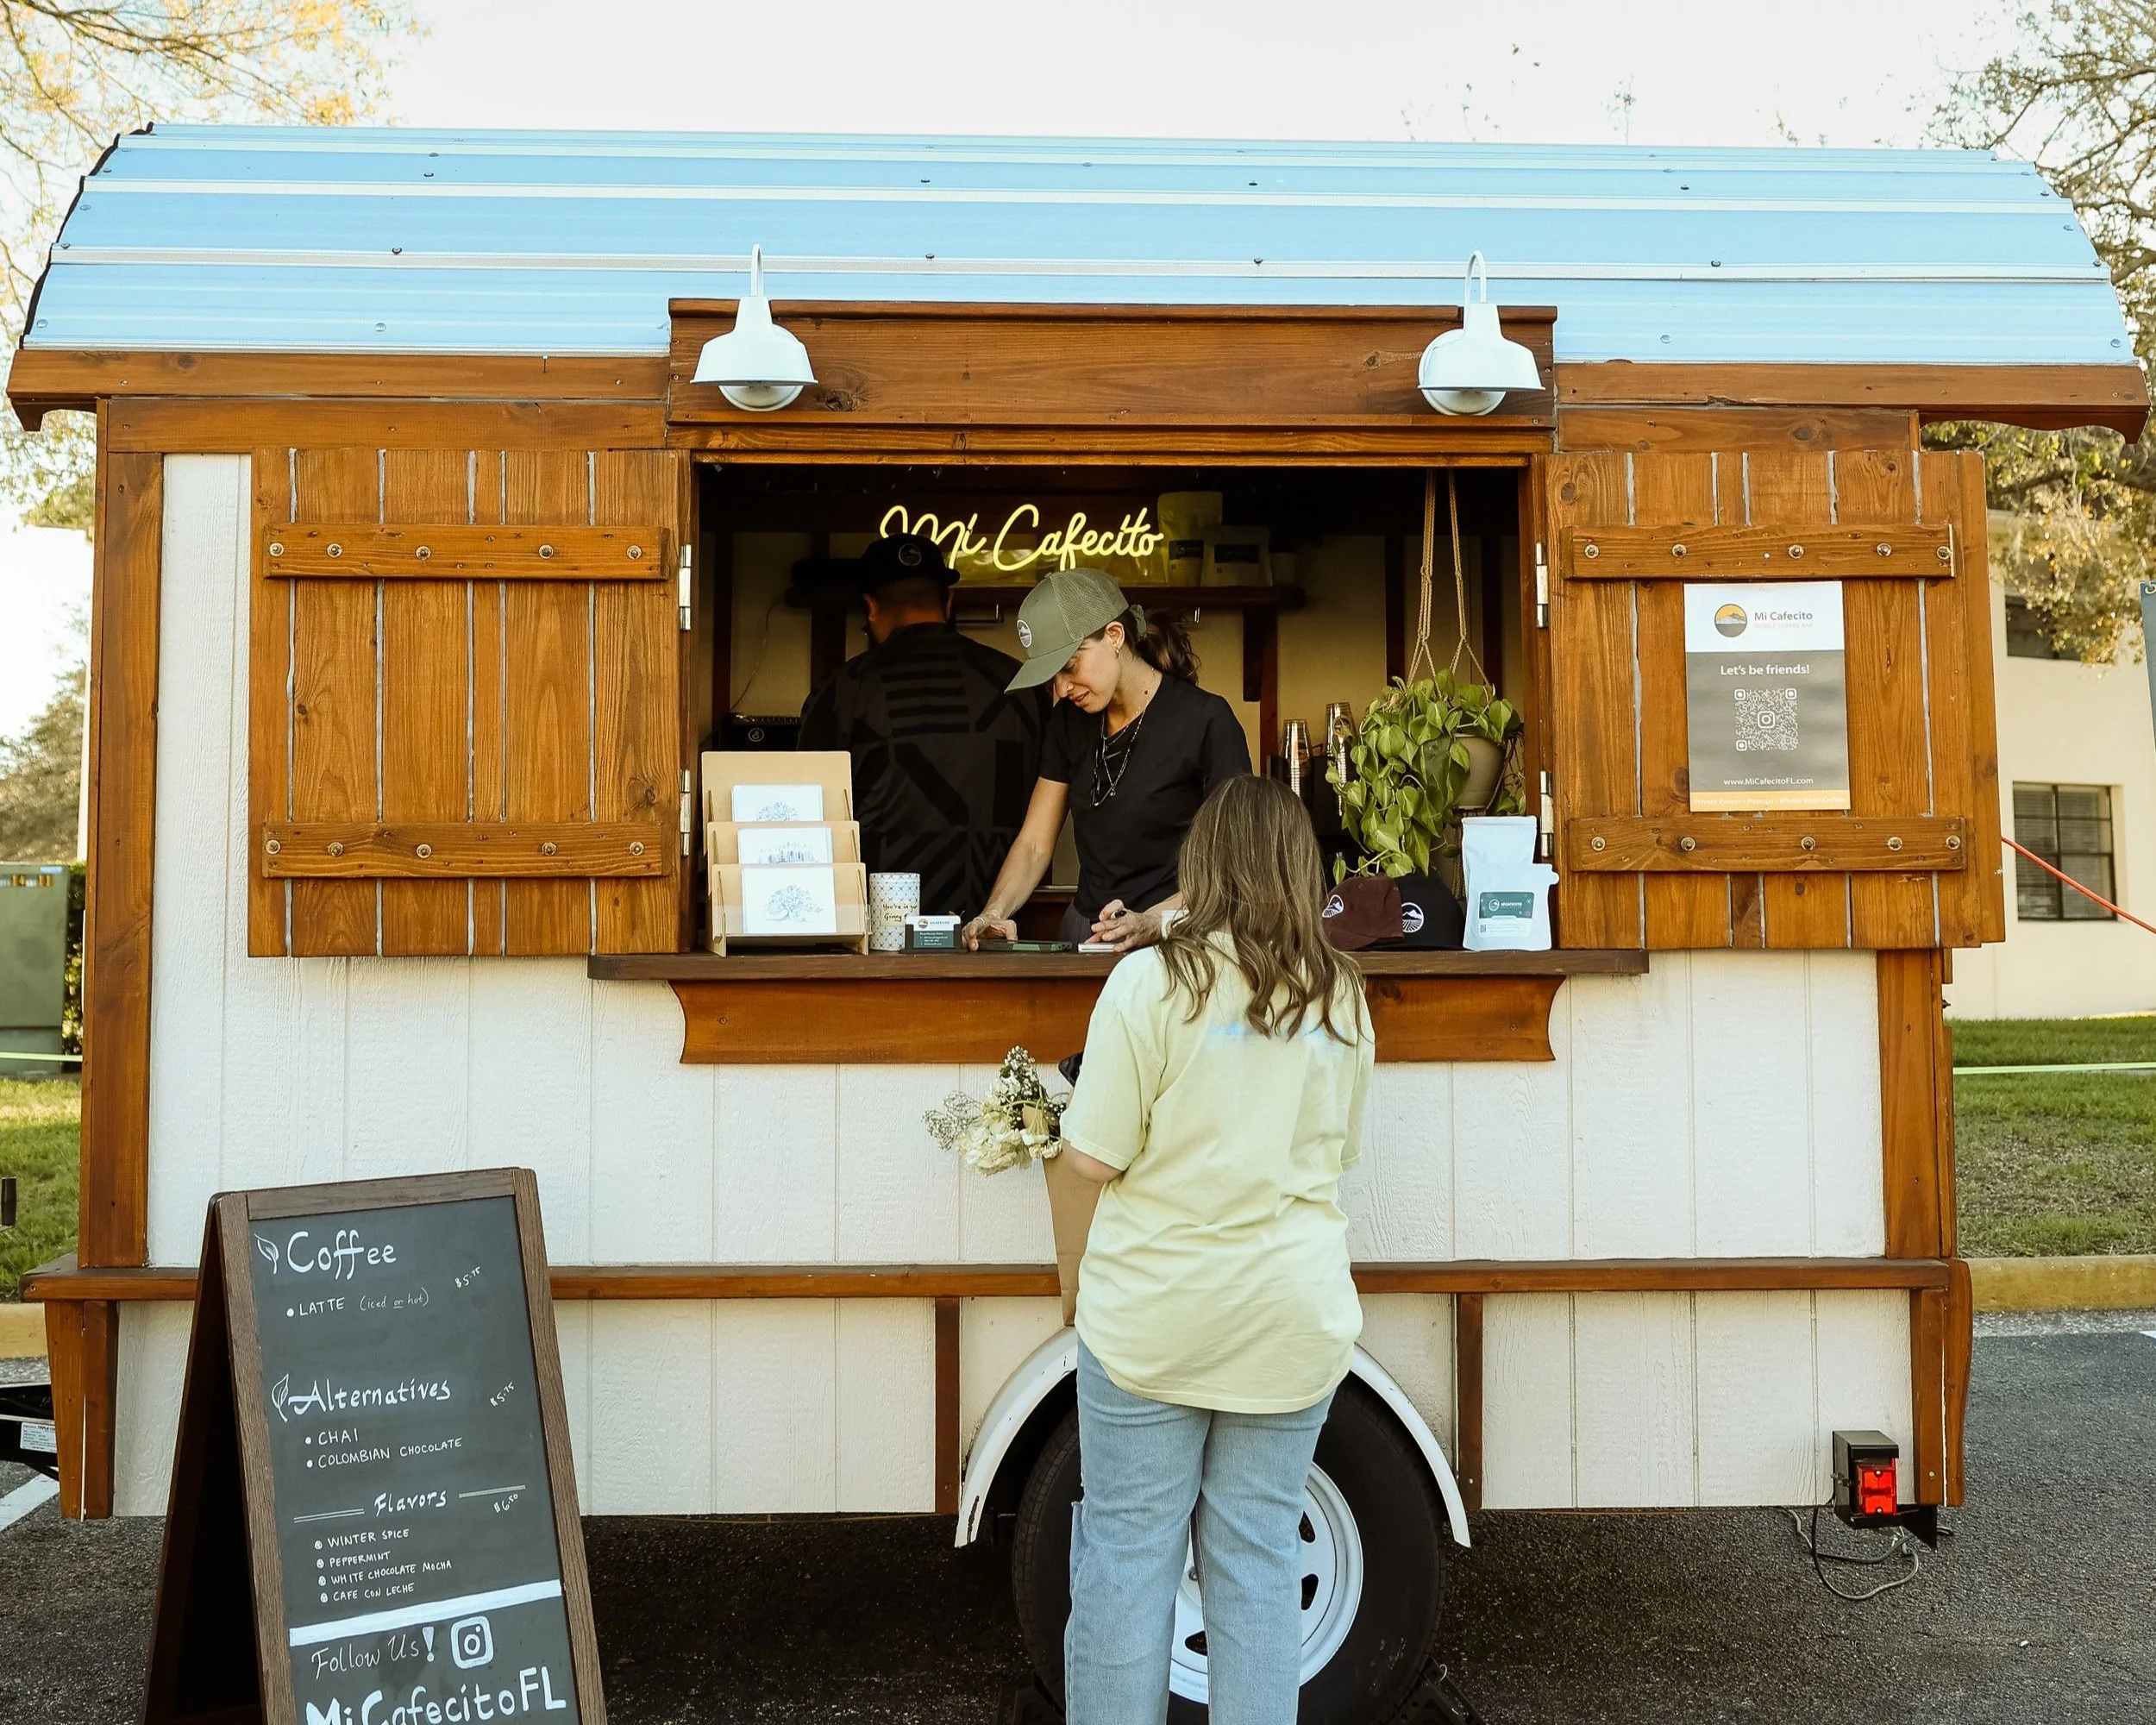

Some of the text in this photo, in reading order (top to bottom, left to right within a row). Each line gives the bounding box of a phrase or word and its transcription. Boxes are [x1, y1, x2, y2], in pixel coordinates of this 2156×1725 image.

[880, 503, 1164, 572] Mi Cafecito
[1754, 611, 1813, 621] Mi Cafecito
[1720, 664, 1810, 675] Let's be friends!
[1724, 777, 1814, 786] www.MiCafecitoFL.com
[286, 1229, 397, 1280] Coffee
[299, 1297, 345, 1316] LATTE
[360, 1295, 387, 1311] (iced
[393, 1300, 404, 1308] or
[407, 1287, 429, 1307] hot)
[288, 1378, 451, 1414] Alternatives
[318, 1427, 359, 1446] CHAI
[318, 1437, 462, 1468] COLOMBIAN CHOCOLATE
[374, 1490, 447, 1517] Flavors
[328, 1528, 410, 1548] WINTER SPICE
[329, 1551, 391, 1568] PEPPERMINT
[331, 1559, 452, 1585] WHITE CHOCOLATE MOCHA
[333, 1582, 415, 1602] CAFE CON LECHE
[311, 1625, 435, 1679] Follow Us!
